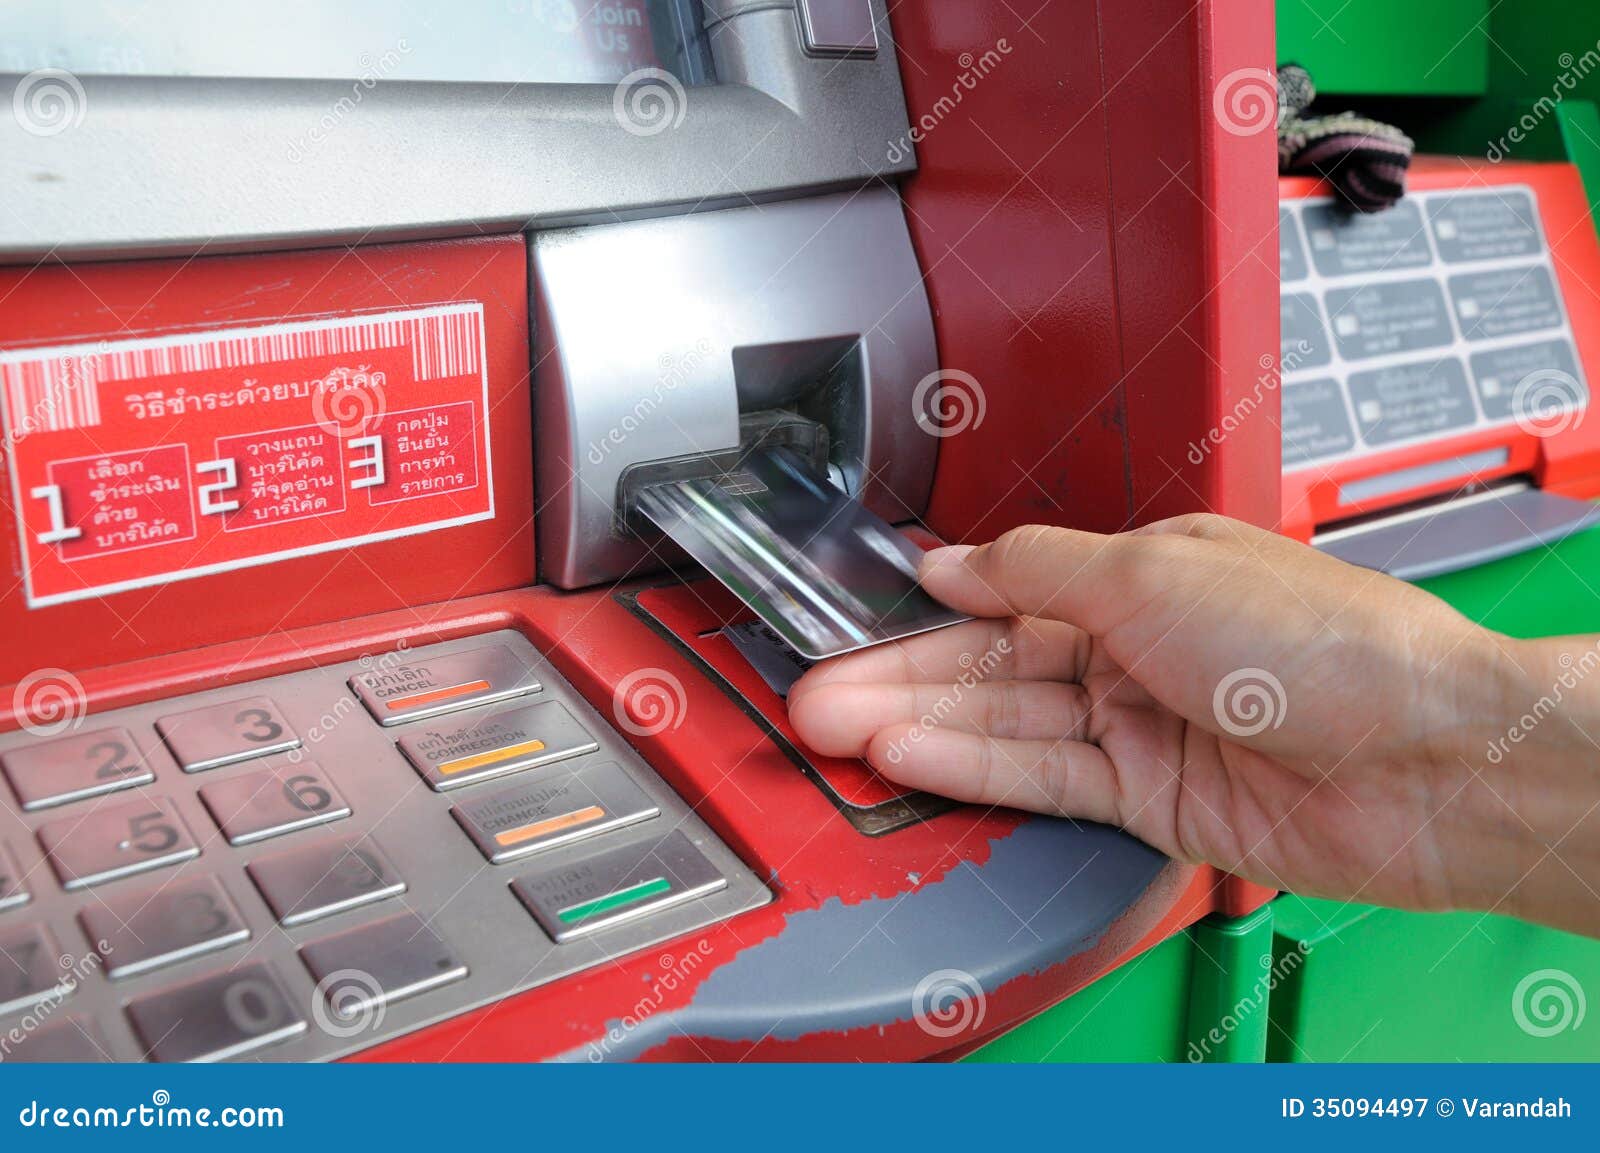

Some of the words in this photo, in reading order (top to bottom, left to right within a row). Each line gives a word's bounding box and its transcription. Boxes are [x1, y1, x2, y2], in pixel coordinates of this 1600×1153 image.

[592, 2, 642, 26] Join
[597, 29, 629, 52] Us
[348, 435, 385, 490] 3
[195, 457, 239, 516] 2
[400, 473, 465, 494] รายการ
[30, 485, 82, 544] 1
[375, 680, 437, 698] CANCEL
[234, 708, 284, 743] 3
[85, 740, 140, 780] 2
[426, 730, 527, 761] CORRECTION
[281, 773, 333, 812] 6
[128, 810, 180, 854] 5
[223, 978, 280, 1035] 0
